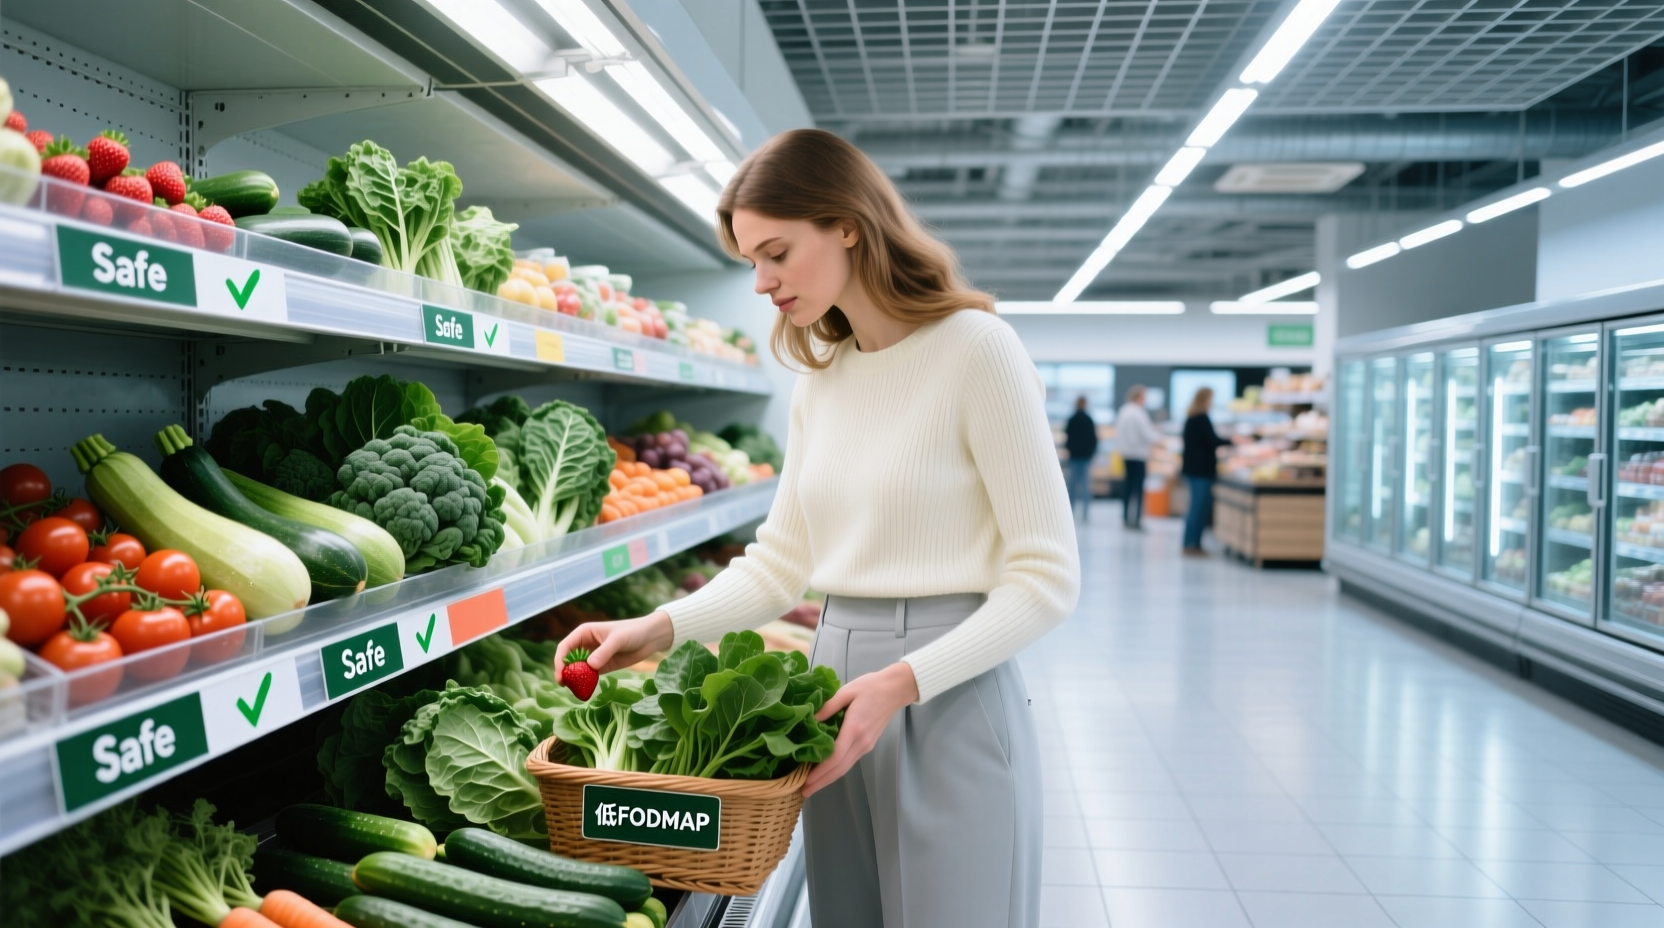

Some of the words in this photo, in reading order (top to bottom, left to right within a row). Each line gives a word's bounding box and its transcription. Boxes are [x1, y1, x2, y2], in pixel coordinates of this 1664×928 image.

[92, 242, 168, 291] Safe
[435, 314, 463, 340] Safe
[341, 639, 386, 680] Safe
[93, 718, 175, 783] Safe
